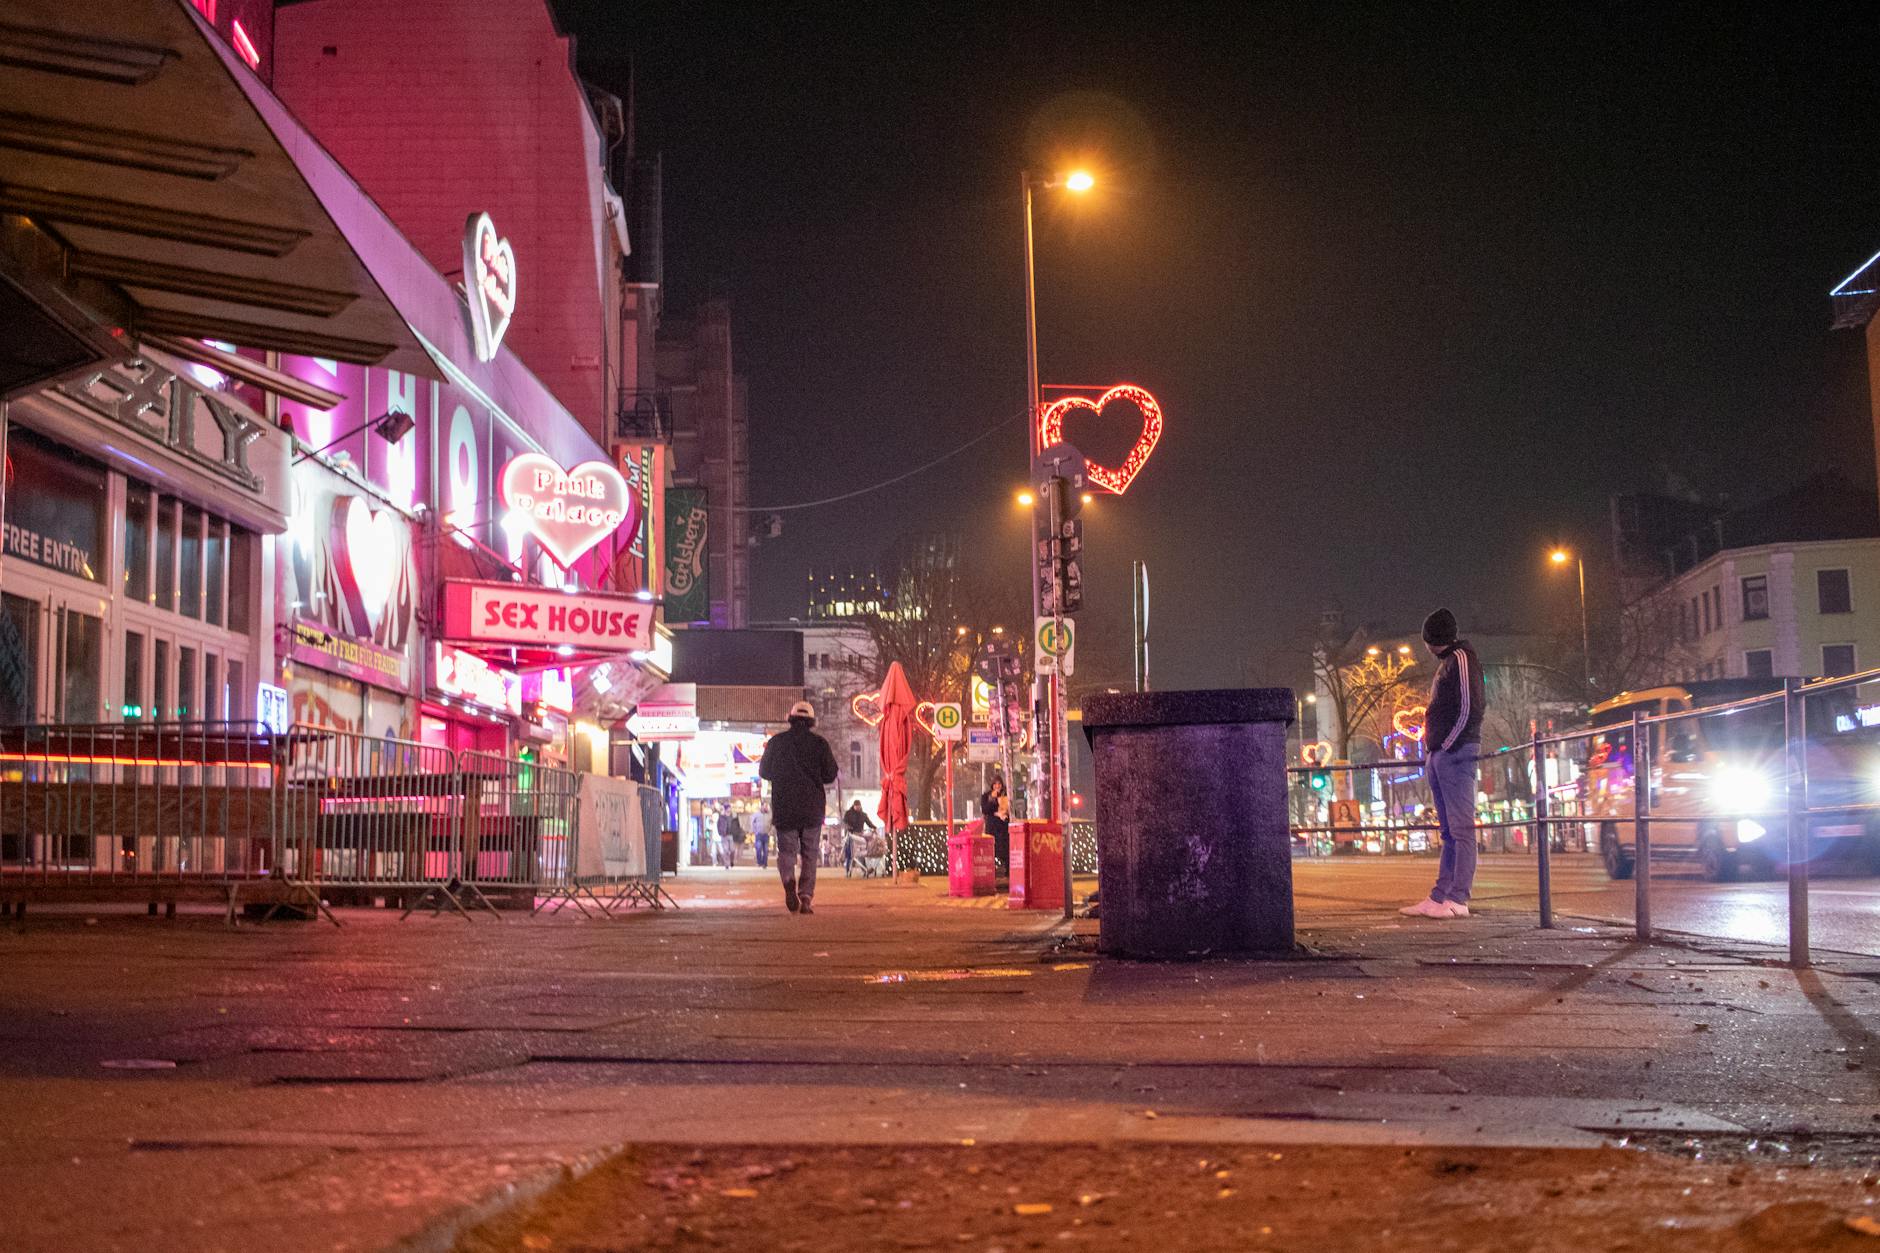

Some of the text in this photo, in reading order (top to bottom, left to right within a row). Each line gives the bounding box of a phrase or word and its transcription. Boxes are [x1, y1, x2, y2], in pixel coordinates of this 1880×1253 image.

[533, 467, 606, 500] Pink
[641, 448, 650, 509] EXPRESS
[512, 492, 620, 530] Palace
[3, 522, 90, 578] FREE ENTRY
[665, 506, 709, 597] Carlsberg
[484, 600, 640, 639] SEX HOUSE
[340, 639, 359, 664] FREI
